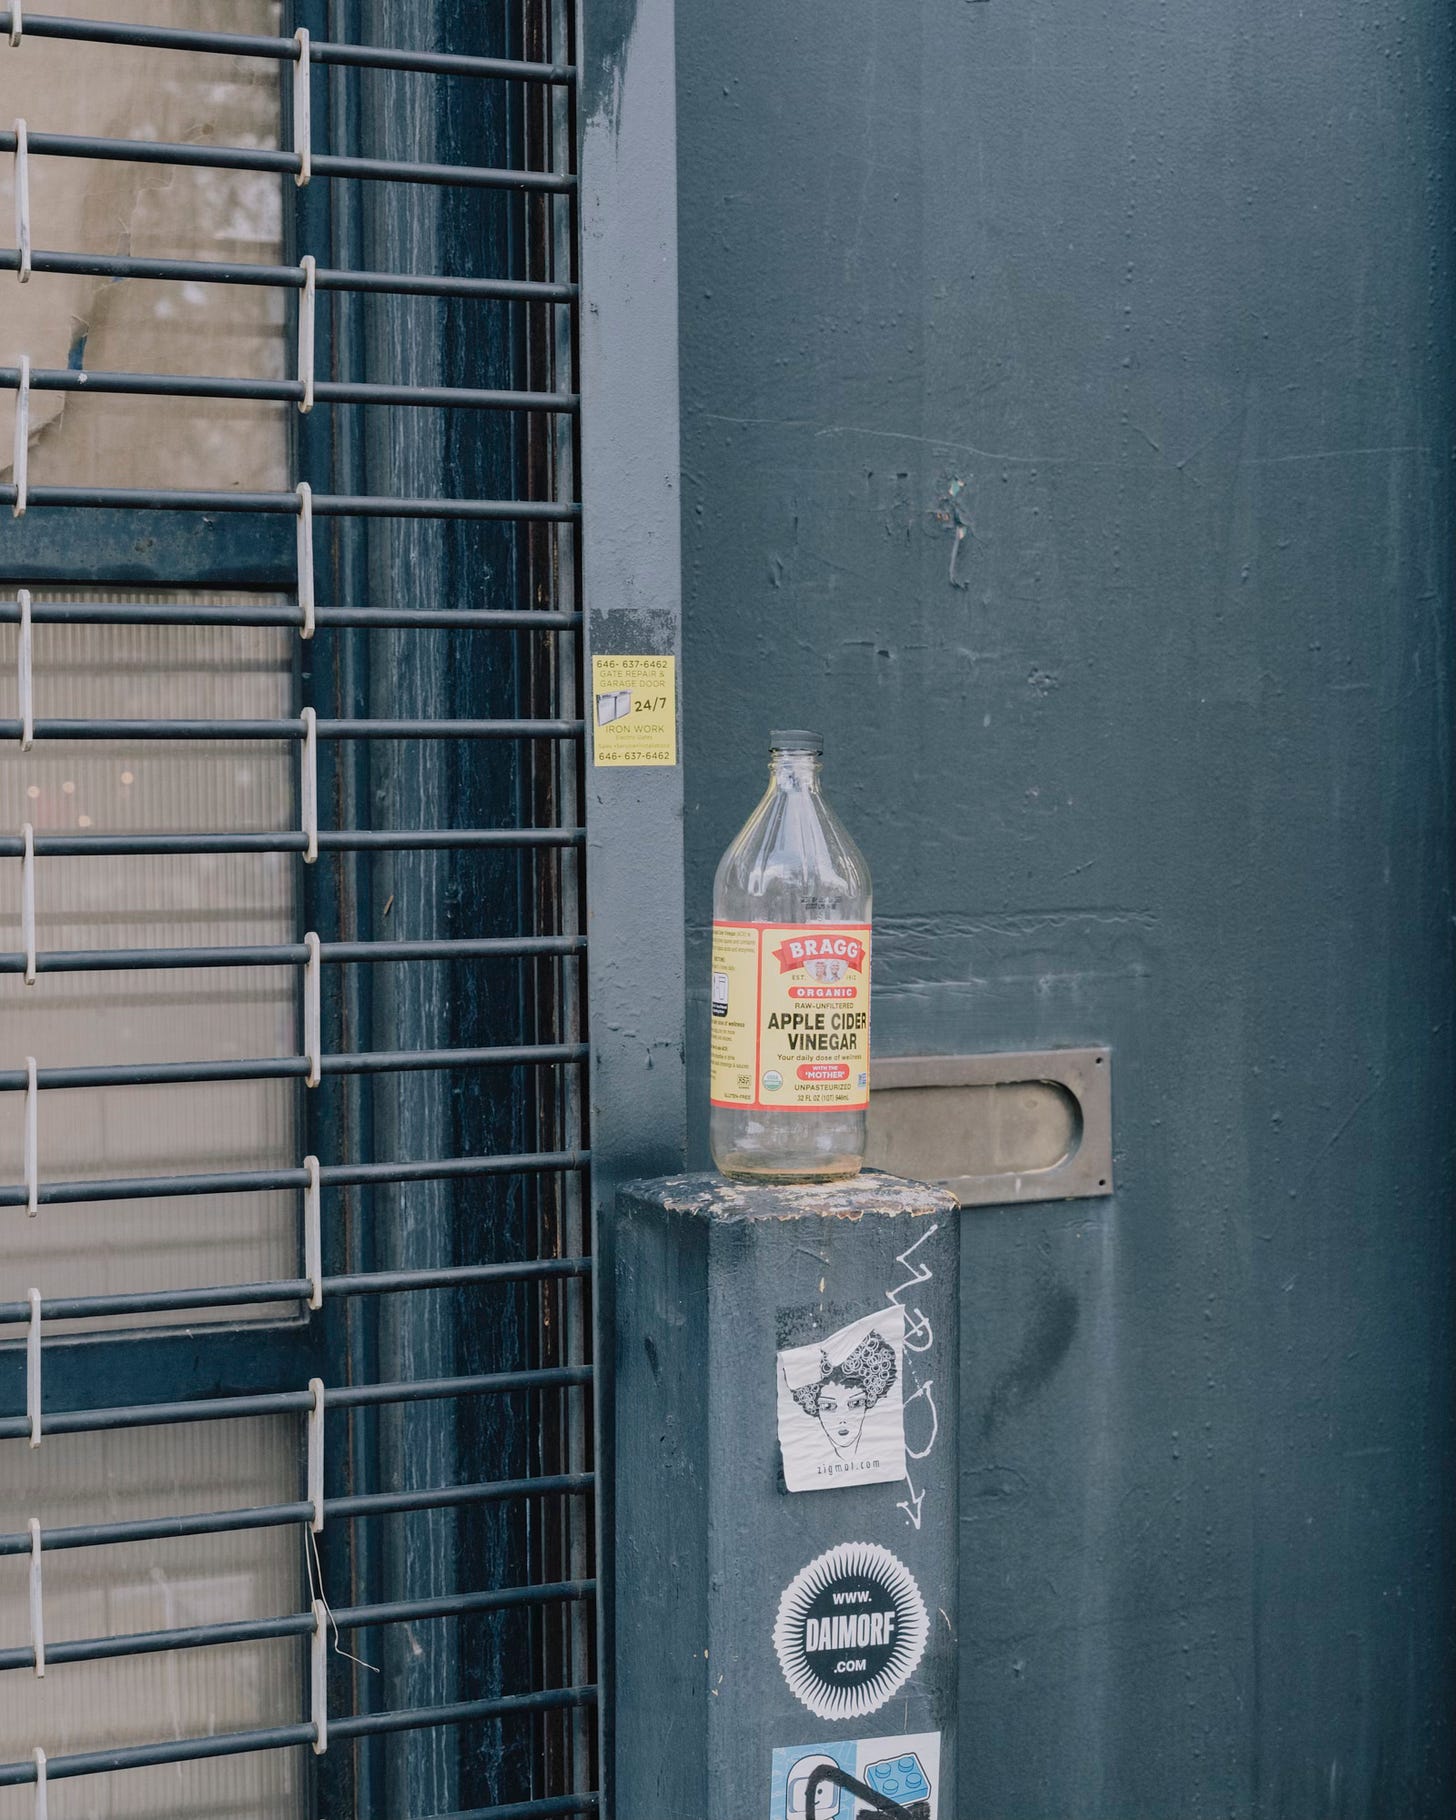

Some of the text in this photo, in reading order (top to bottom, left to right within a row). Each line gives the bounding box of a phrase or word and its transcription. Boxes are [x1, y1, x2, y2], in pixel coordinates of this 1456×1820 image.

[597, 660, 668, 668] 646- 637-6462
[600, 670, 624, 678] GATE
[626, 670, 656, 678] REPAIR
[634, 697, 667, 712] 24/7
[606, 725, 665, 733] IRON WORK
[624, 752, 670, 760] 637-6462
[789, 939, 858, 959] BRAGG
[796, 988, 853, 997] ORGANIC
[768, 1012, 867, 1030] APPLE CIDER
[787, 1033, 857, 1050] VINEGAR
[796, 1054, 813, 1062] daily
[805, 1611, 896, 1652] DAIMORF
[833, 1659, 867, 1673] .COM
